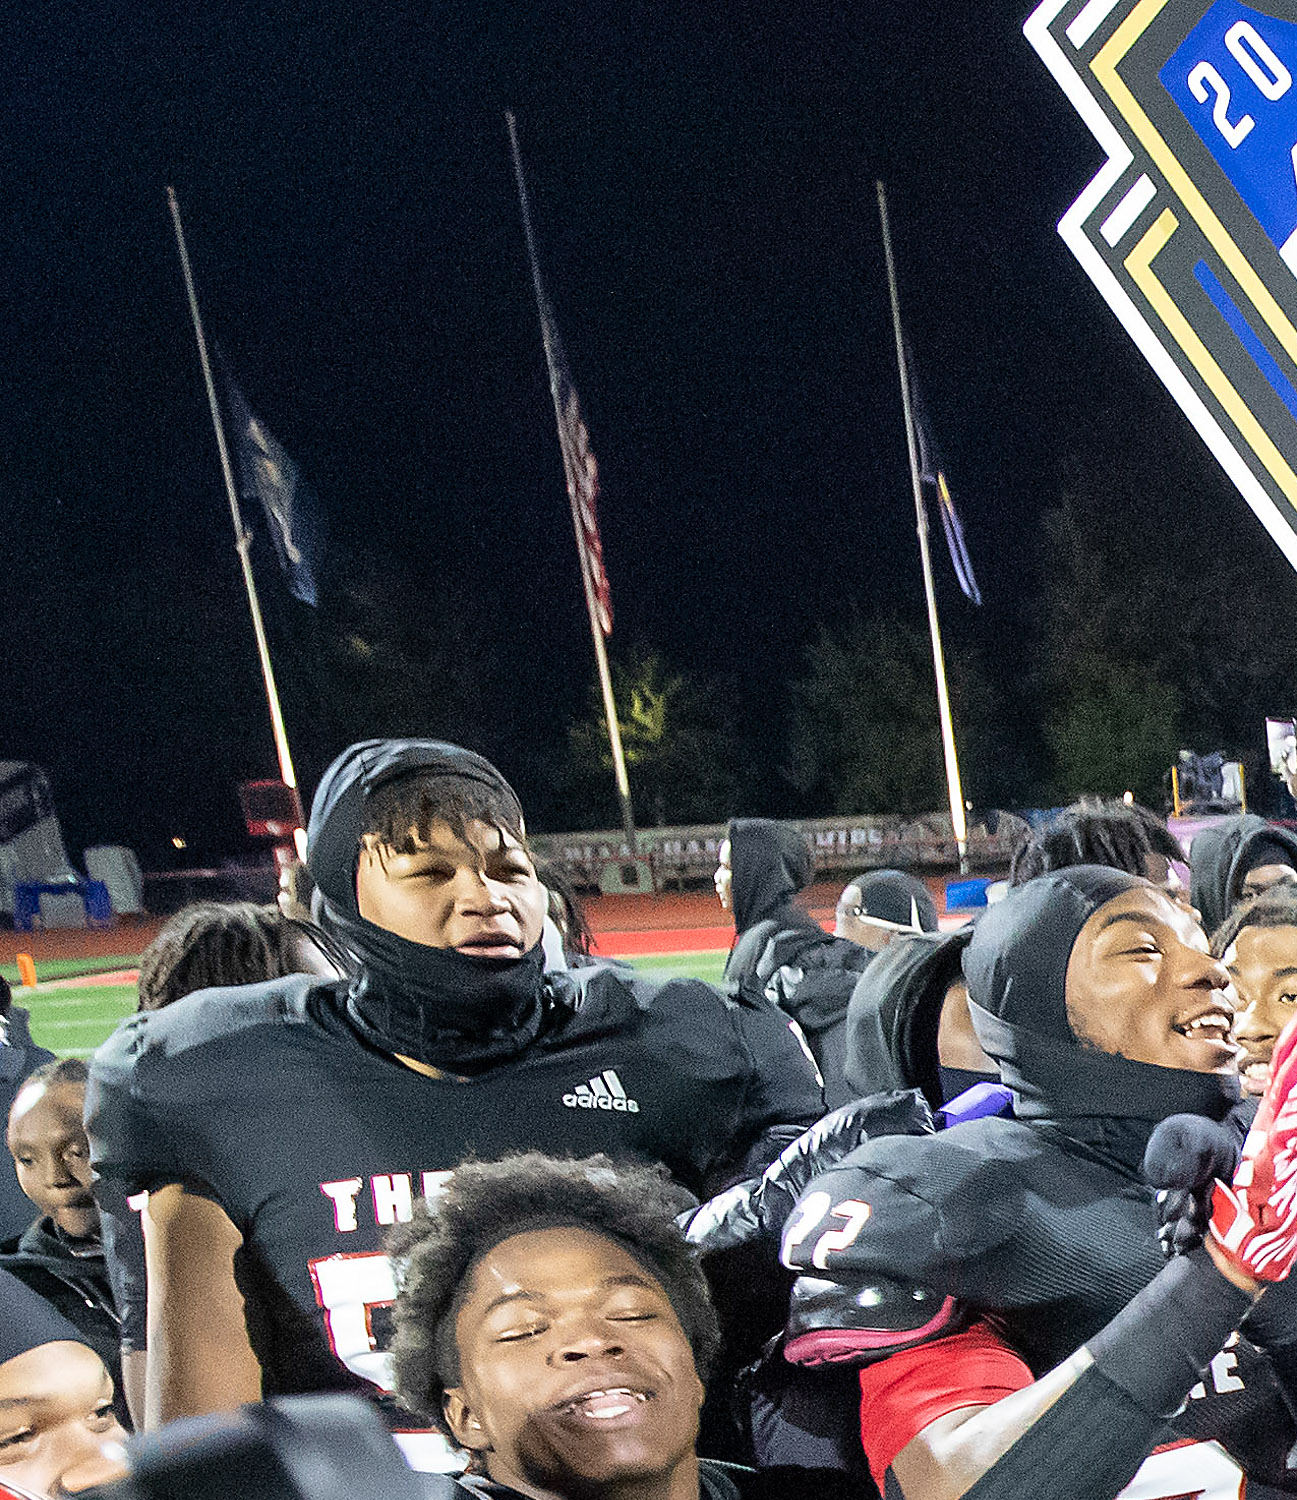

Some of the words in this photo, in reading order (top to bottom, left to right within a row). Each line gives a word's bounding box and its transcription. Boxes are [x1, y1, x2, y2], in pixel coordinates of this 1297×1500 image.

[1188, 21, 1293, 149] 20
[562, 1092, 640, 1112] adidas
[780, 1191, 872, 1271] 22
